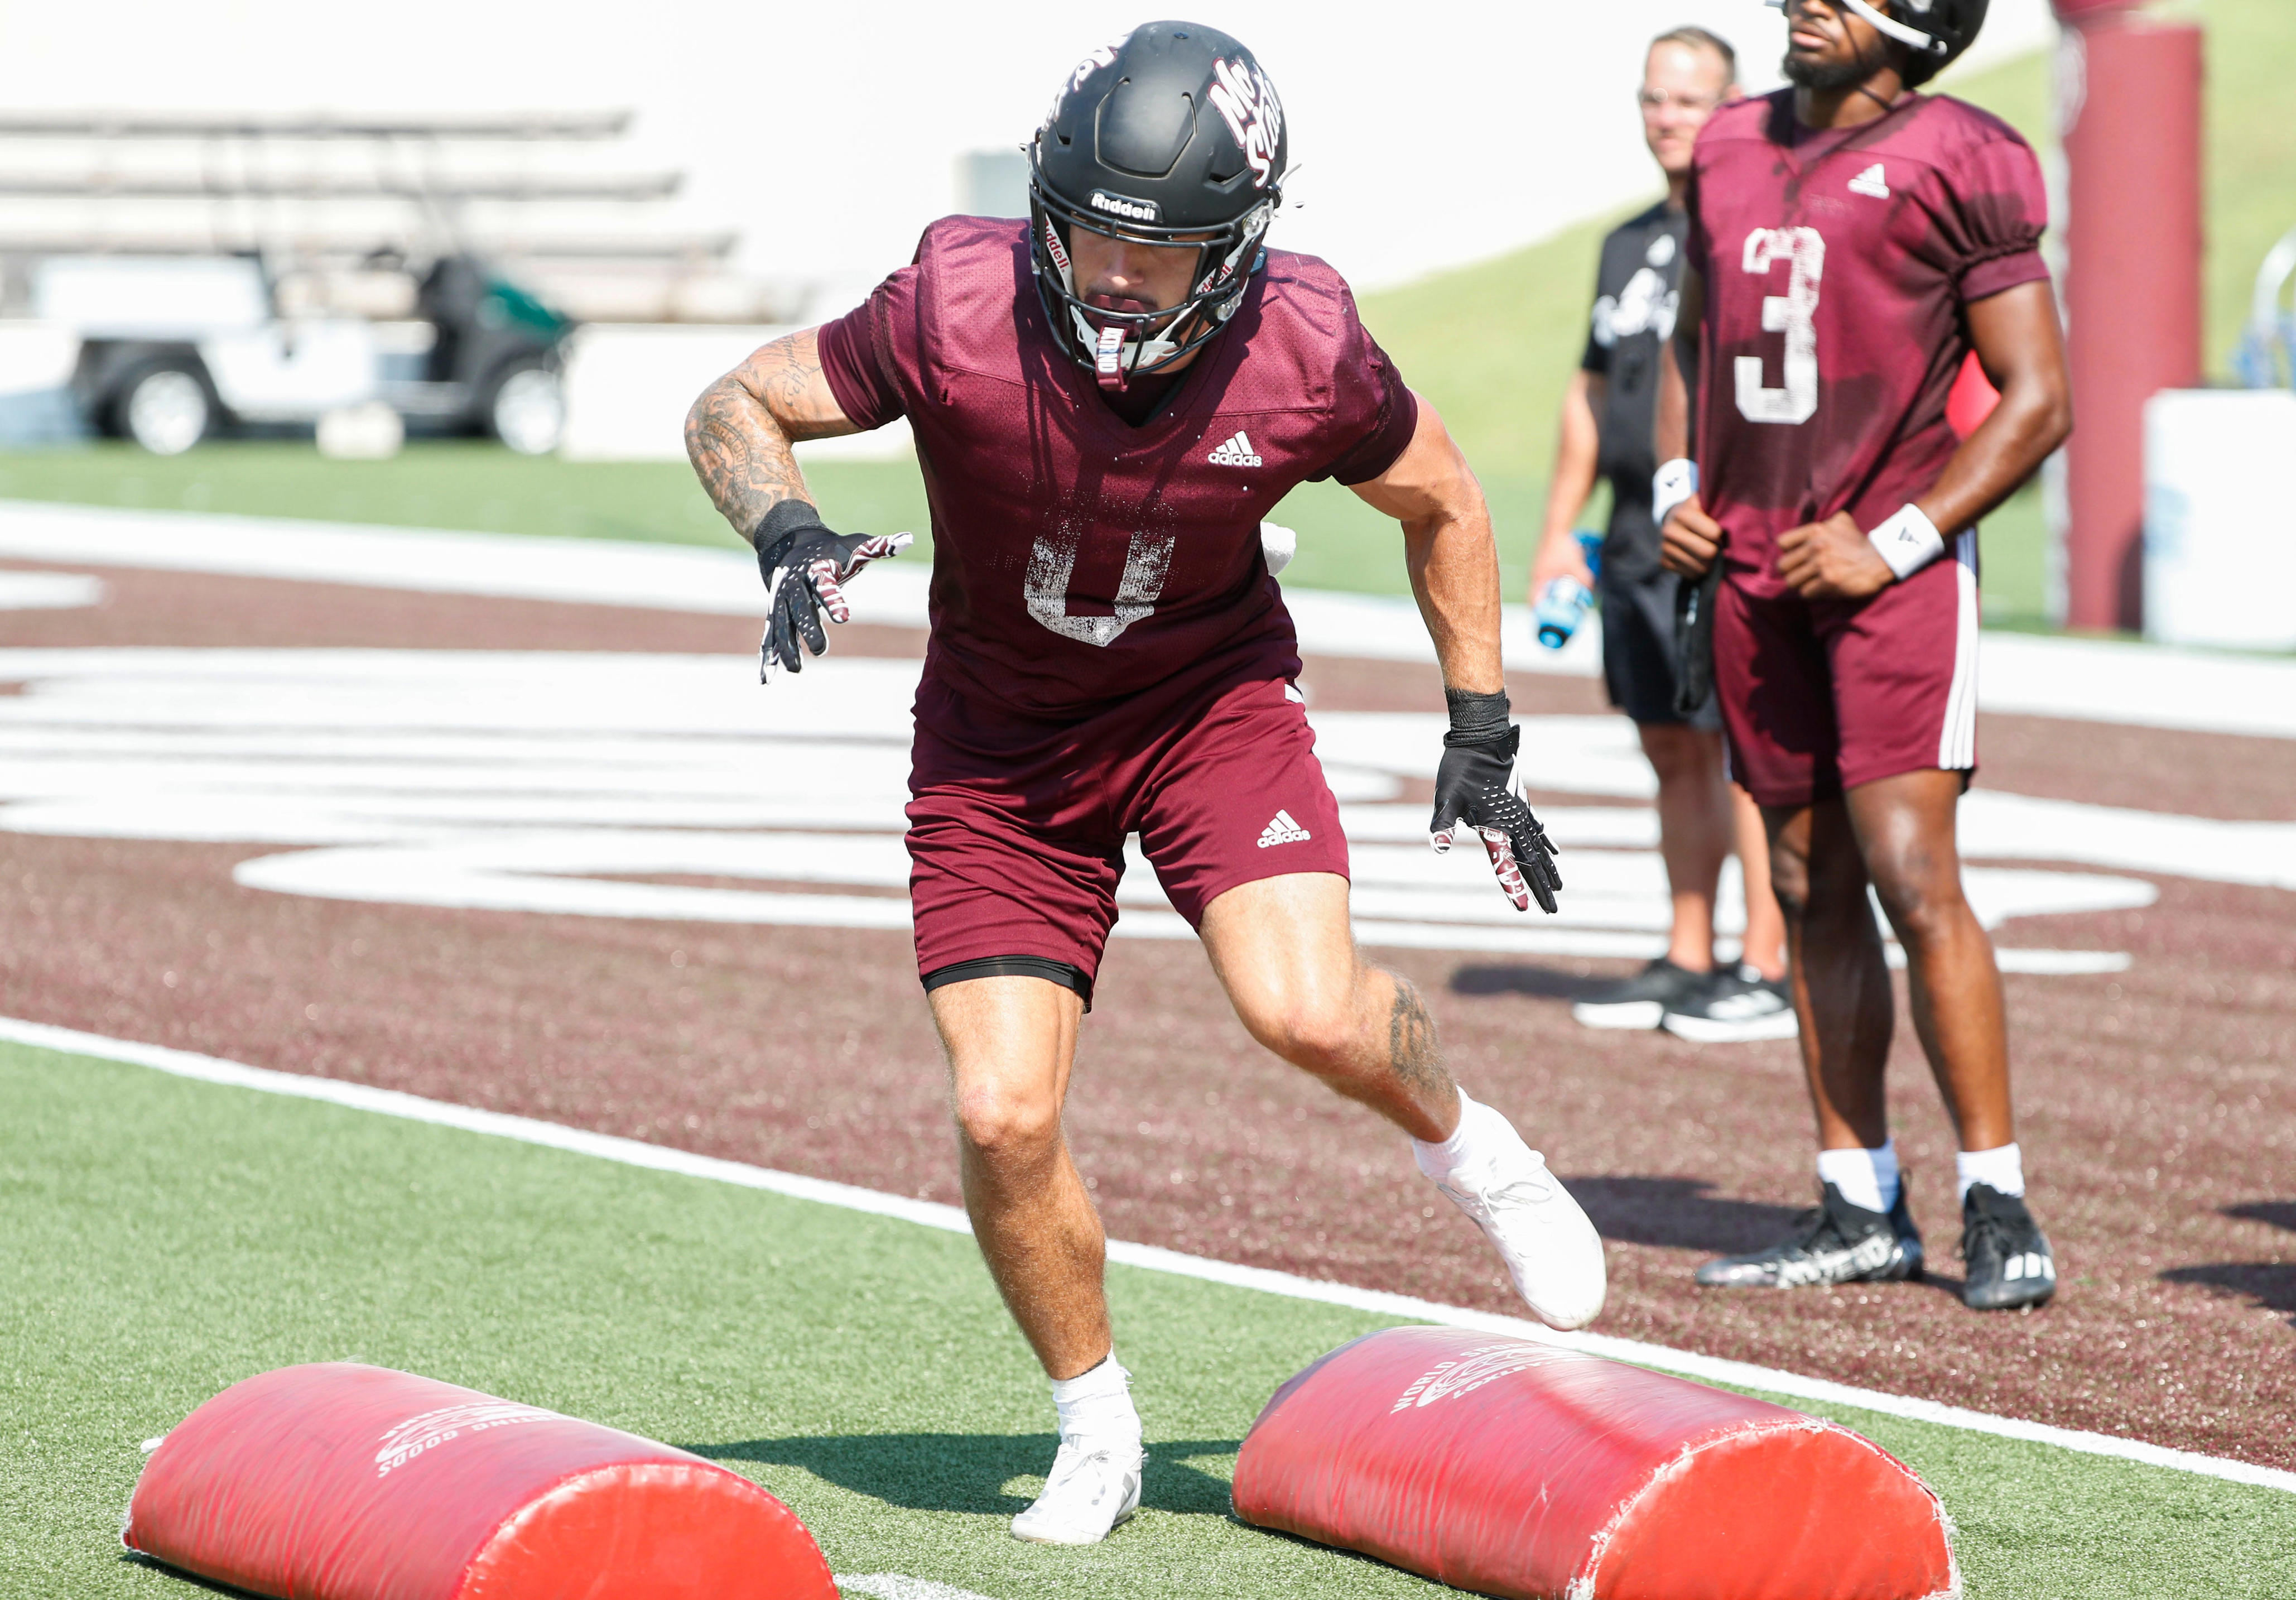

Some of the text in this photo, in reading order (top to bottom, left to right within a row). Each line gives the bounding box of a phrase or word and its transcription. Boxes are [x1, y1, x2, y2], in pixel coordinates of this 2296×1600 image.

[1091, 192, 1156, 220] Riddell
[1734, 226, 1826, 424] 3
[1208, 451, 1263, 467] adidas
[1257, 829, 1311, 848] adidas
[1390, 1361, 1458, 1415] WORLD
[378, 1430, 459, 1478] GOODS
